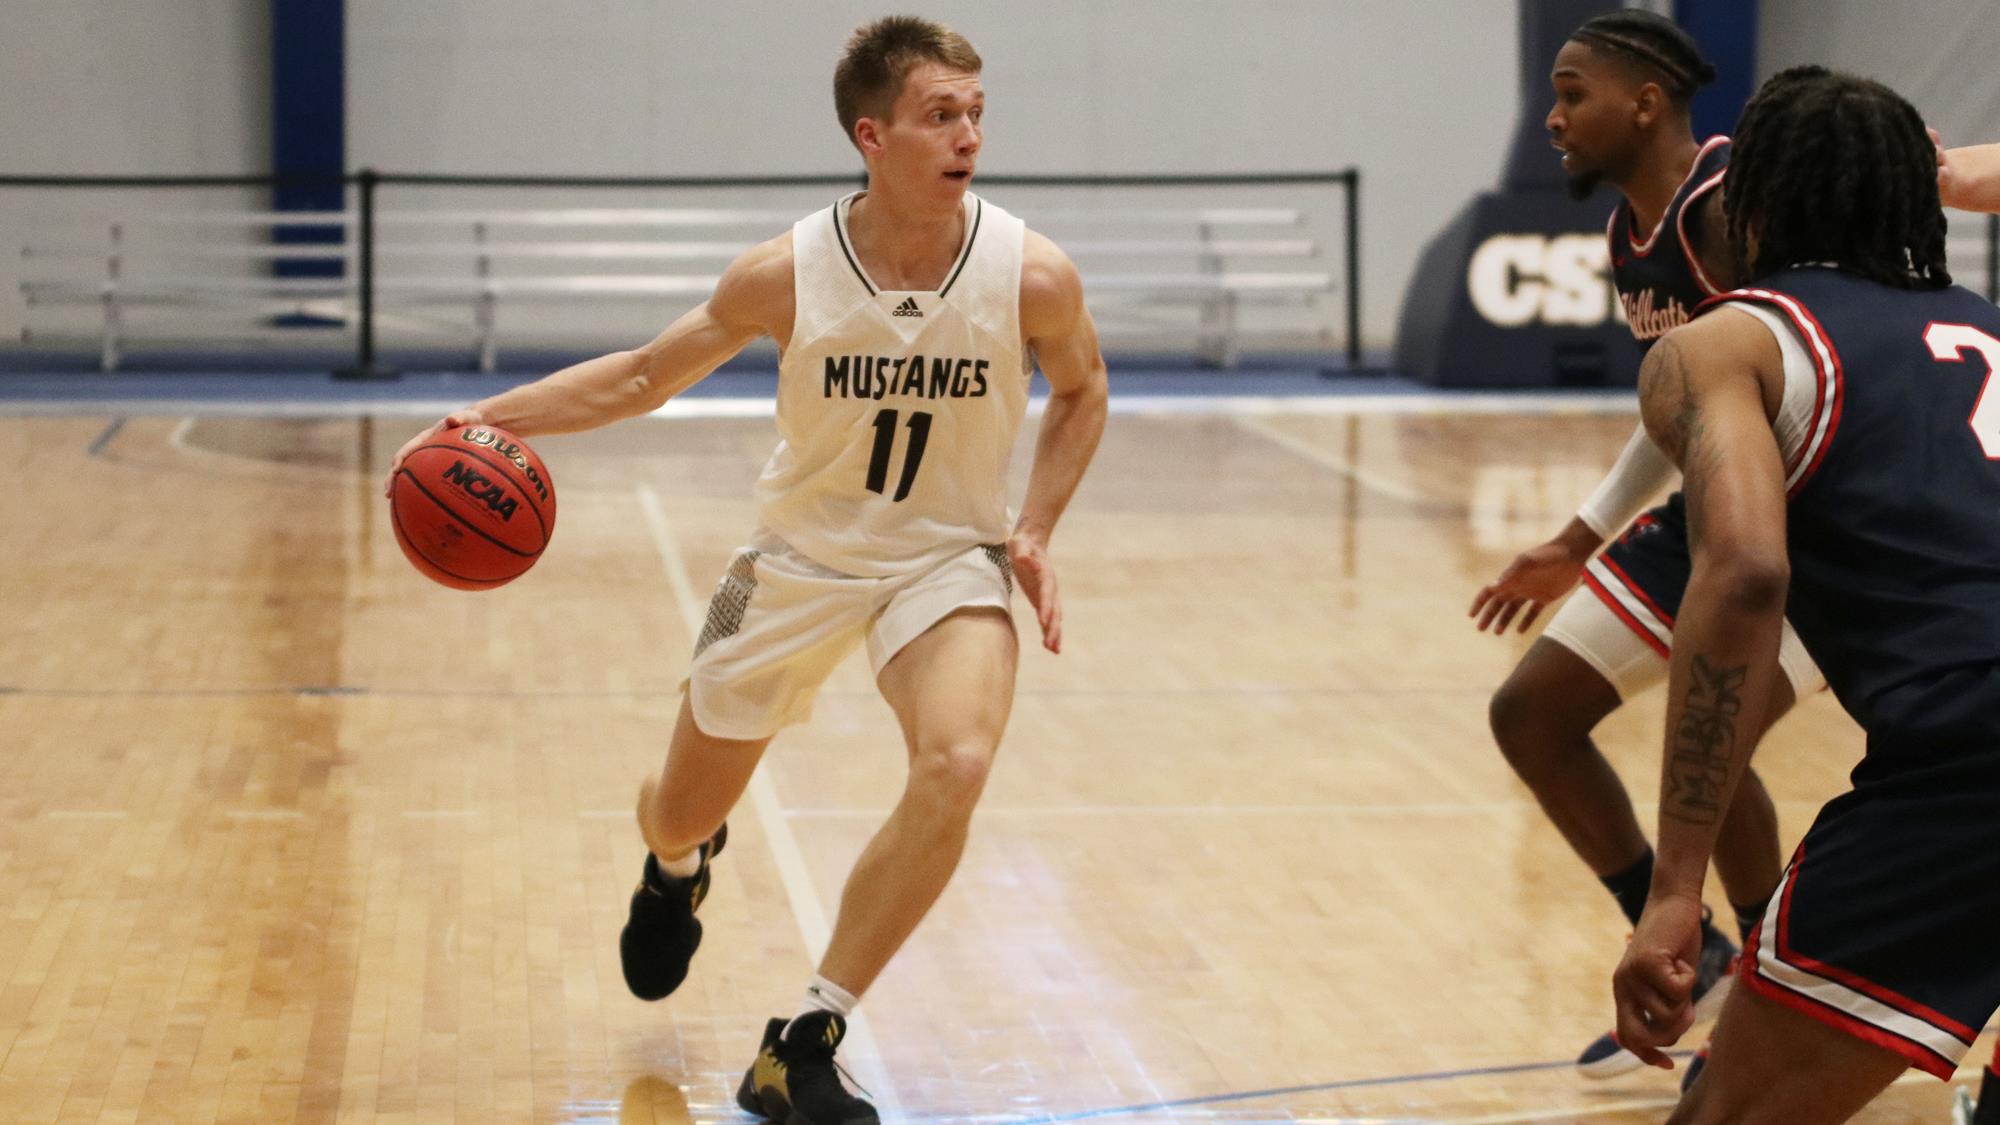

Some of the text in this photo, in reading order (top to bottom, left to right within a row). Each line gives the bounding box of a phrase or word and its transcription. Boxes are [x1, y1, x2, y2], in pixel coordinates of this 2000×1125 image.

[892, 308, 923, 318] adidas
[1468, 233, 1629, 327] CS
[824, 355, 990, 401] MUSTANGS
[1921, 320, 2000, 464] 2
[442, 460, 519, 522] NCAA
[460, 428, 549, 502] Wilson
[865, 408, 933, 503] 11
